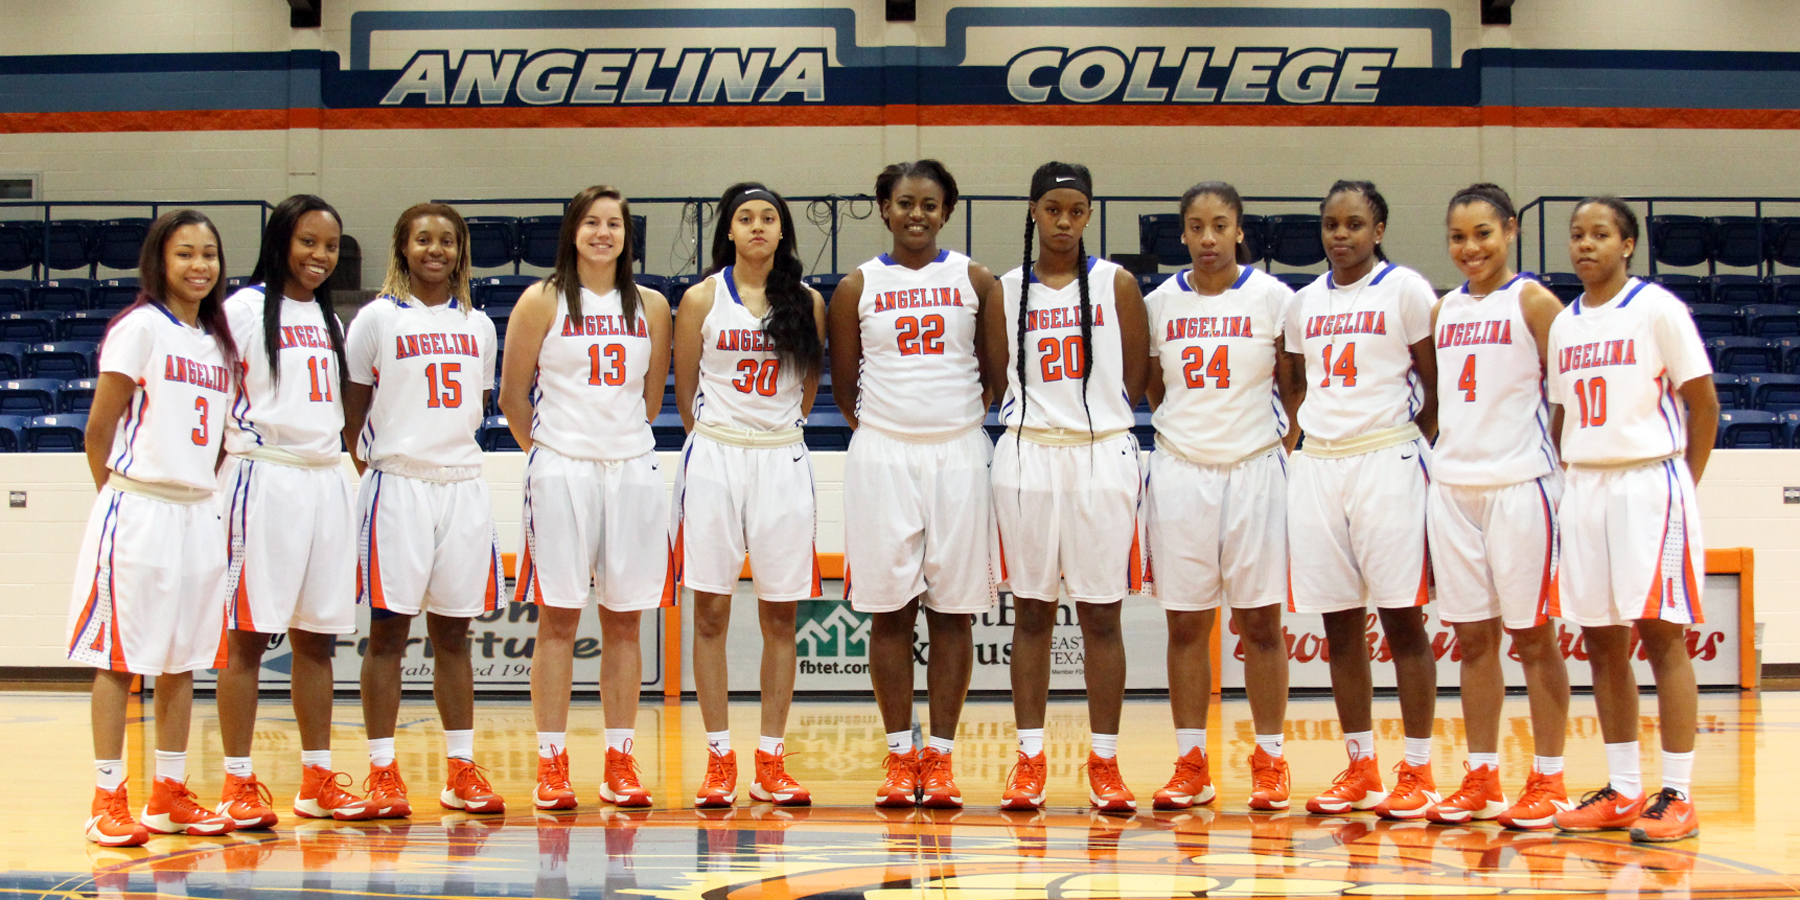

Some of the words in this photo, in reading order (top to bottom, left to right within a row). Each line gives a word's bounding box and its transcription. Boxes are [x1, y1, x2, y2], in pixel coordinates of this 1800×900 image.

[378, 48, 827, 105] ANGELINA
[1004, 47, 1397, 104] COLLEGE
[874, 287, 964, 313] ANGELINA
[1024, 304, 1105, 332] NGELIA
[396, 333, 479, 359] ANGELINA
[716, 328, 775, 351] ANGEL
[895, 314, 945, 356] 22
[1166, 317, 1253, 341] ANGELINA
[1305, 311, 1386, 339] ANGELINA
[1437, 319, 1512, 349] ANGELINA
[307, 355, 333, 402] 11
[588, 343, 626, 386] 13
[732, 358, 780, 397] 30
[1038, 335, 1085, 382] 20
[1182, 345, 1230, 389] 24
[1320, 342, 1357, 388] 14
[1458, 354, 1476, 402] 4
[425, 362, 462, 408] 15
[1573, 376, 1607, 428] 10
[191, 395, 209, 446] 3
[1050, 652, 1084, 665] EXA
